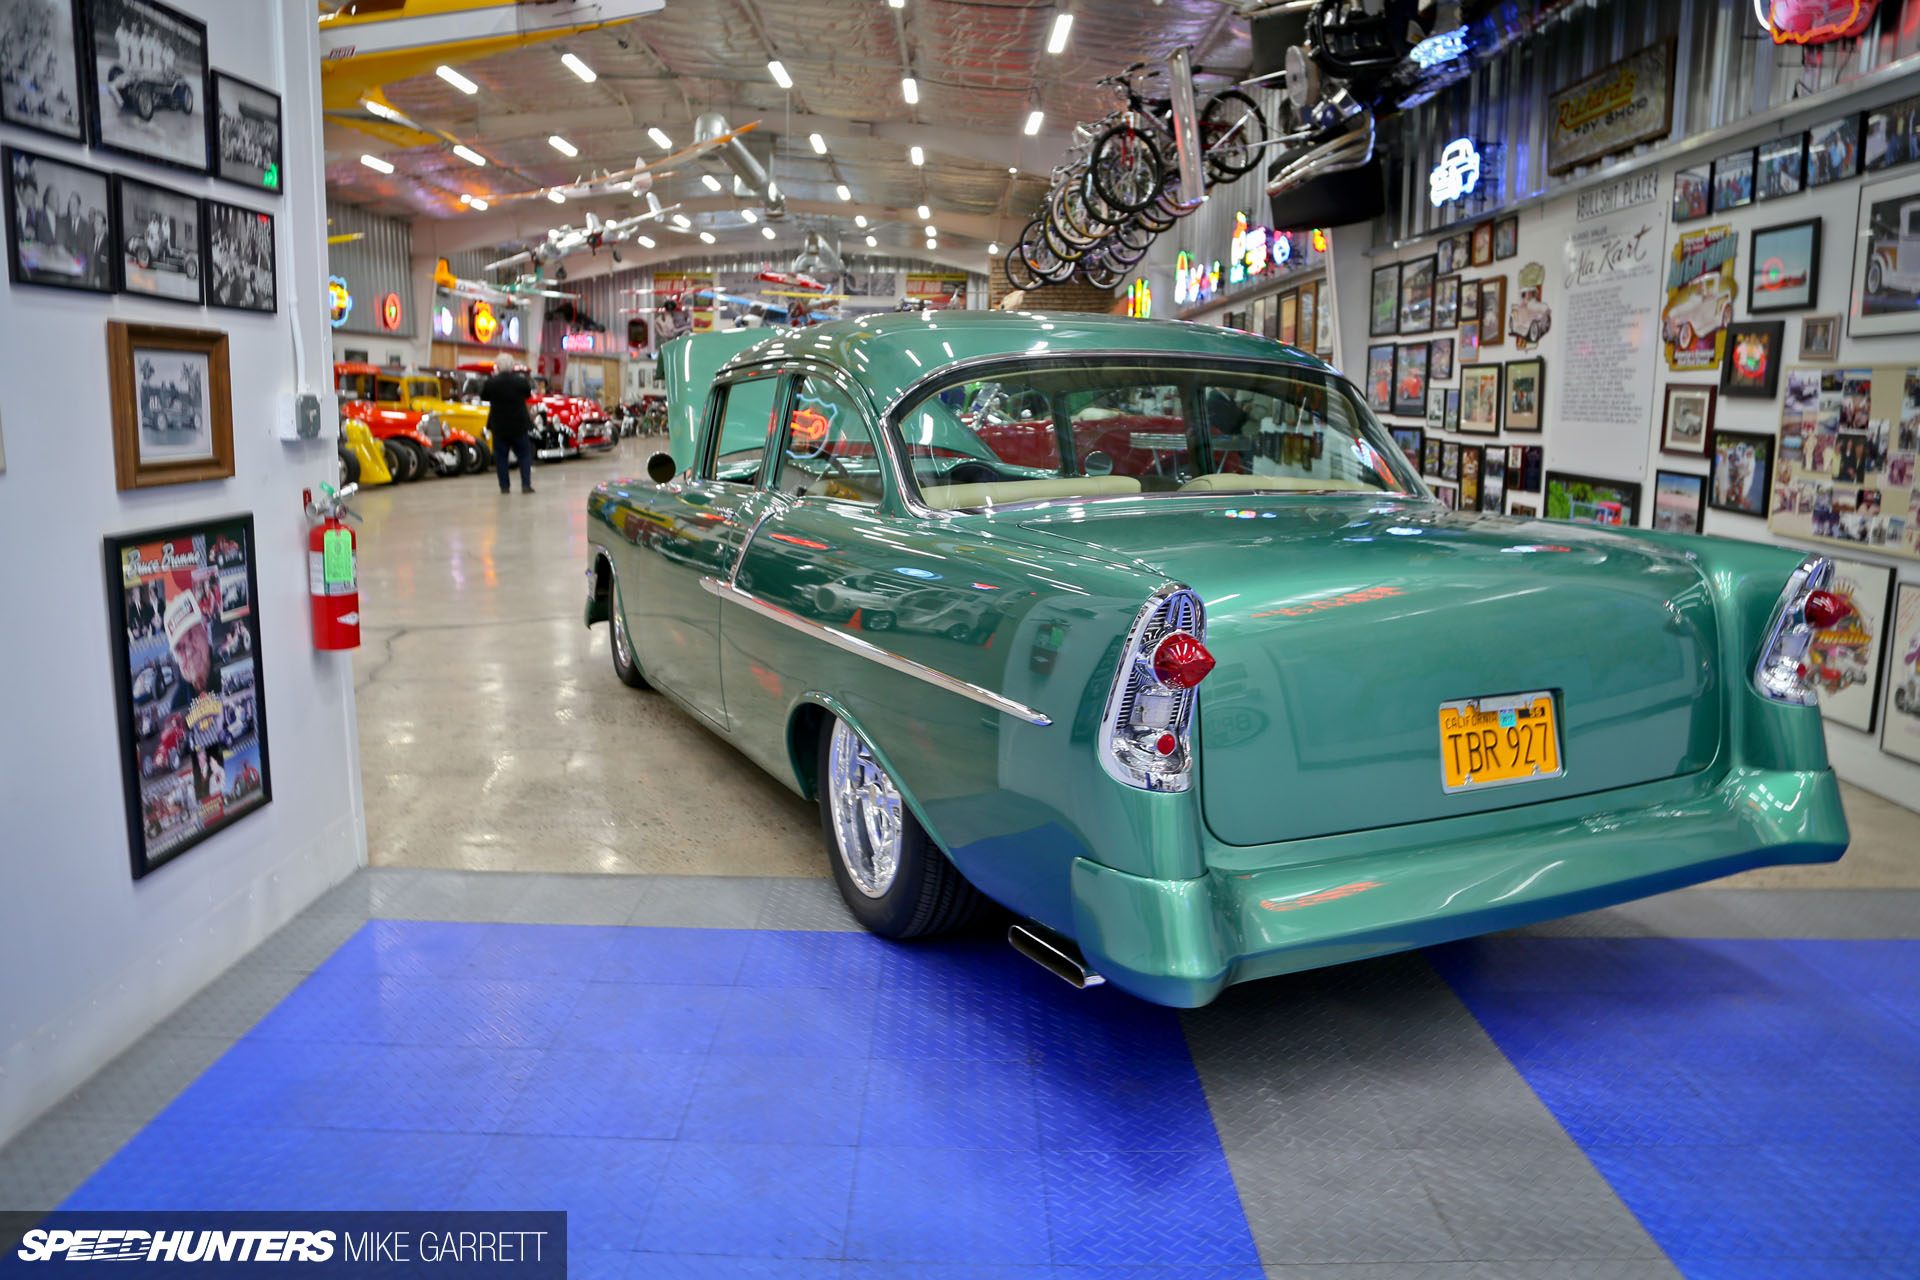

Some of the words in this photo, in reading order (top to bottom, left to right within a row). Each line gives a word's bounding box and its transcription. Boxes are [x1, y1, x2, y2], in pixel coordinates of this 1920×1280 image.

[1574, 121, 1599, 136] TOY
[1606, 97, 1648, 125] SHOP
[1580, 184, 1618, 218] BULLSHIT
[1624, 173, 1654, 204] PLACE
[127, 549, 159, 579] Bruce
[1445, 710, 1498, 730] CALIFORNIA
[1448, 729, 1501, 775] TBR
[1506, 722, 1548, 768] 927
